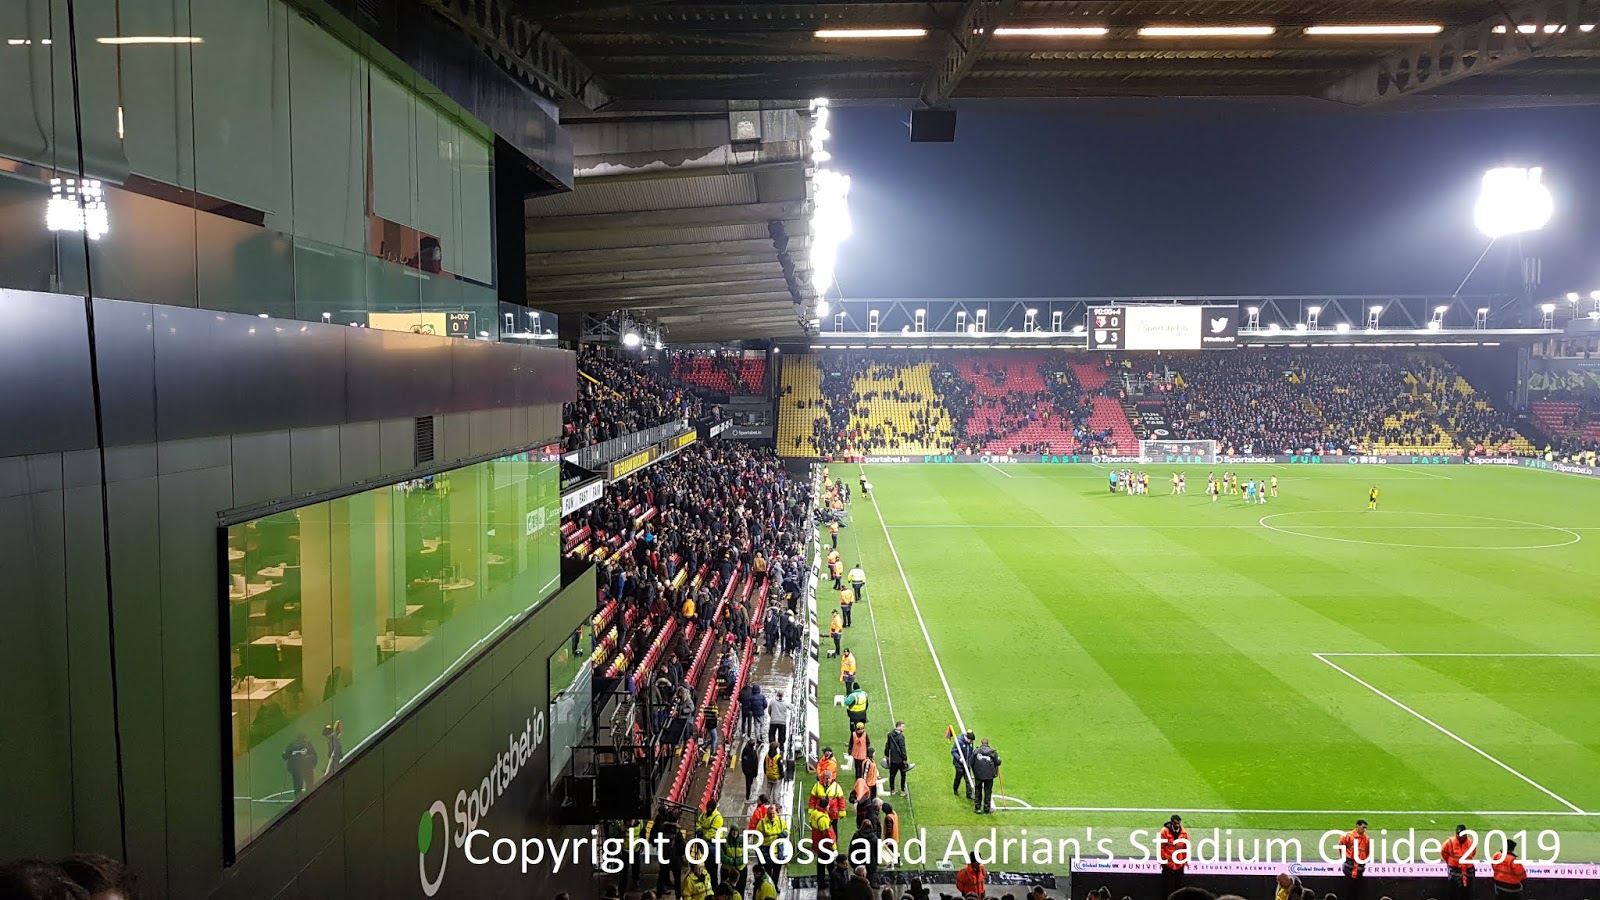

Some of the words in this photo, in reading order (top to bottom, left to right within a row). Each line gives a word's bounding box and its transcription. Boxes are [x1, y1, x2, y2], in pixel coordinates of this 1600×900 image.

[1110, 316, 1119, 327] 0
[1110, 332, 1119, 343] 3
[924, 455, 953, 463] FUN
[1041, 455, 1080, 463] FAST
[1101, 455, 1153, 464] Sportsbeio
[1166, 455, 1202, 463] FAIR
[1224, 456, 1275, 464] Sportsbet.io
[1290, 455, 1321, 463] FUN
[1411, 456, 1450, 464] FAST
[1524, 459, 1547, 469] FAIR
[1558, 463, 1593, 475] Sportsbet.io
[454, 707, 545, 851] Sportsbet.io
